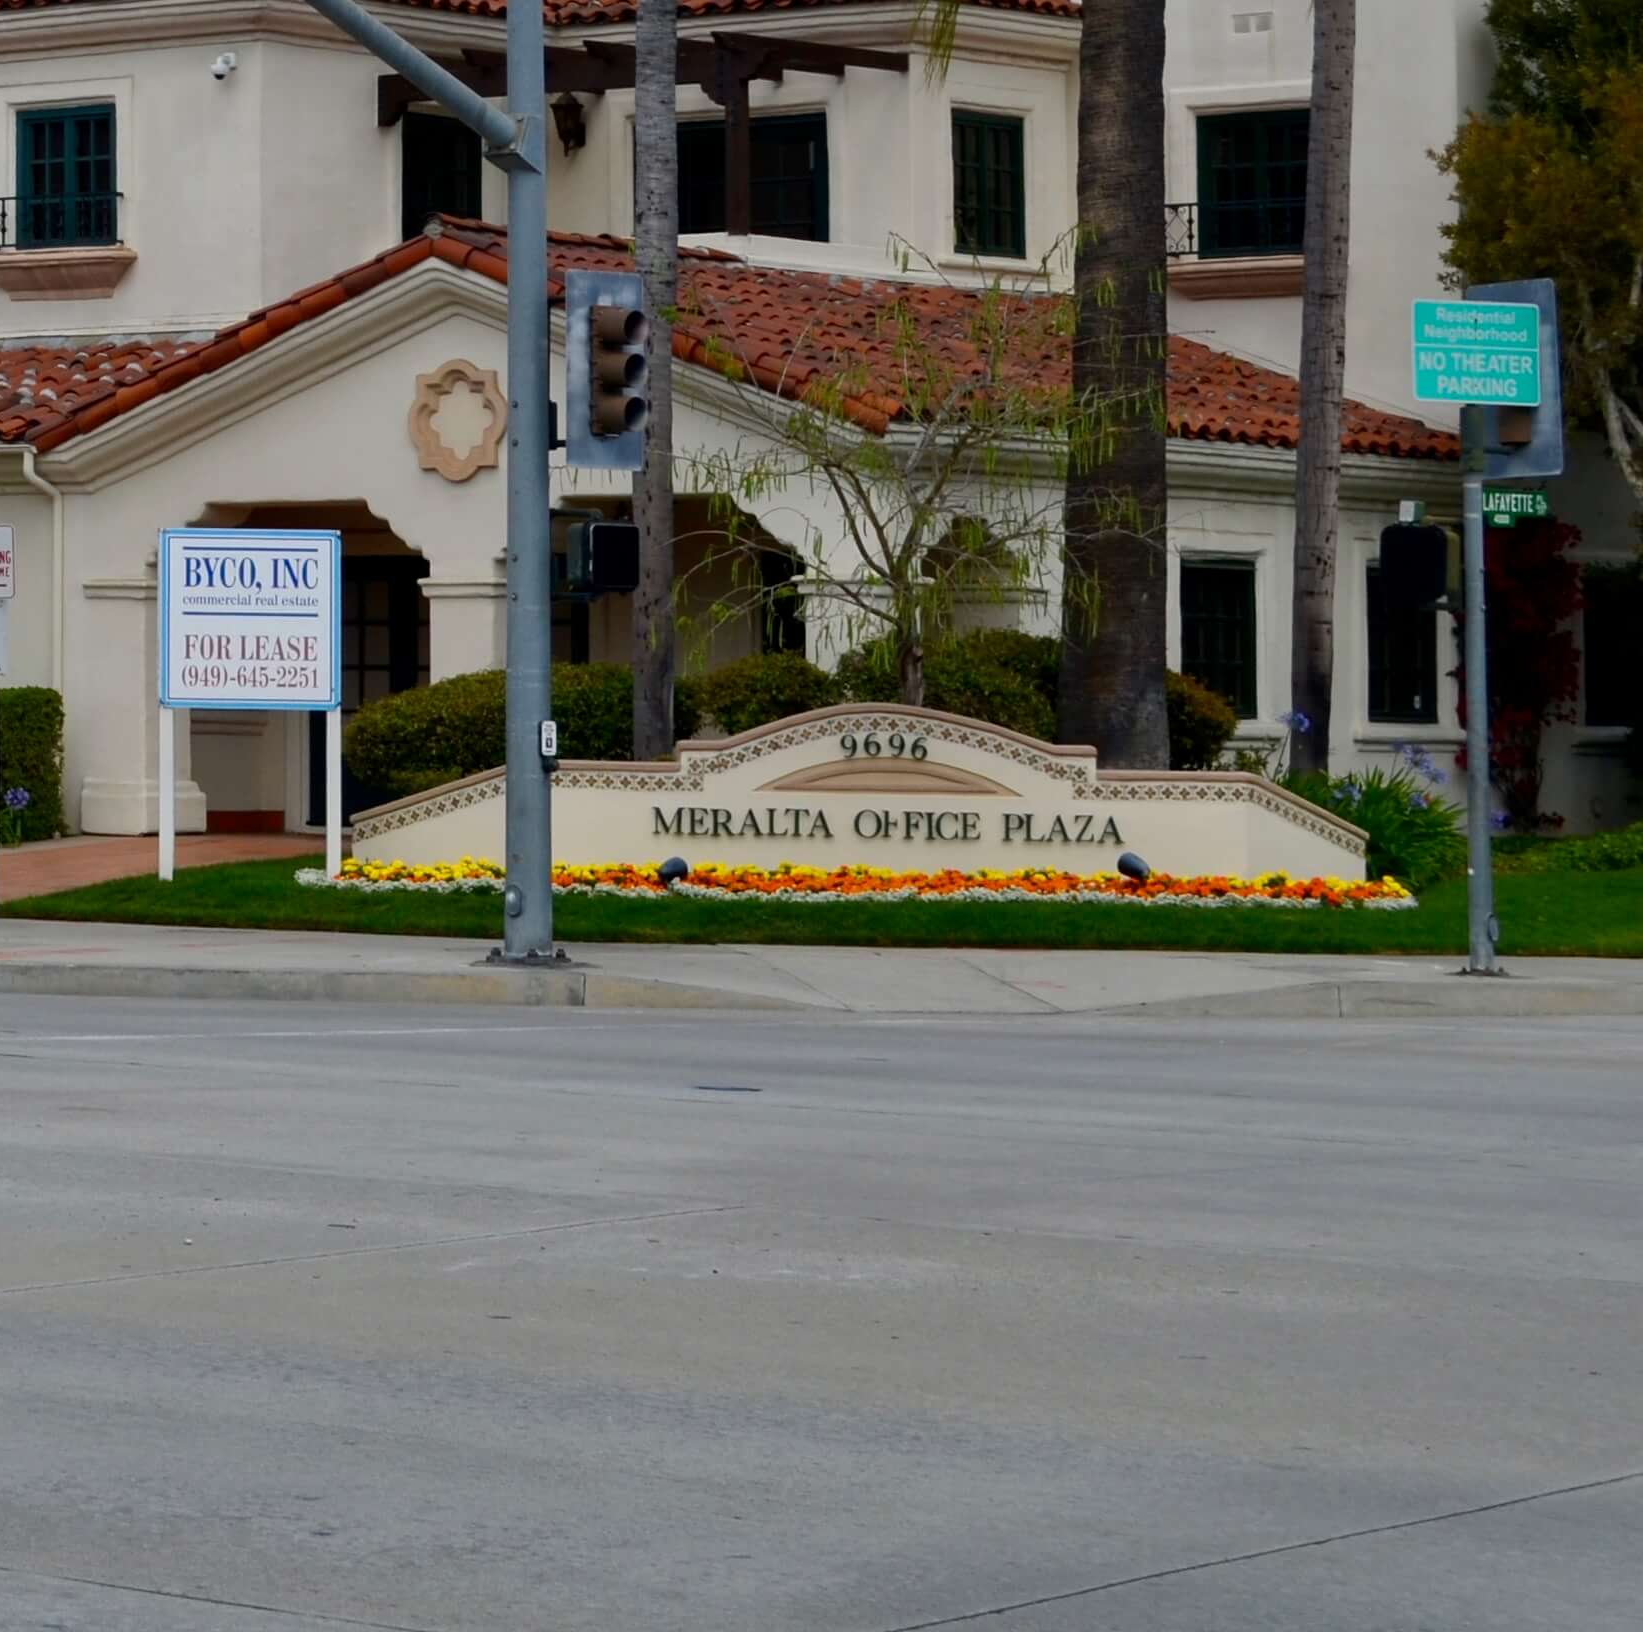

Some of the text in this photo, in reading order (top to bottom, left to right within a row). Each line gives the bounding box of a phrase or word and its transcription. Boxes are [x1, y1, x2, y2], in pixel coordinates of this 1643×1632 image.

[1435, 306, 1516, 325] Residential
[1423, 324, 1528, 343] Neighborhood
[1418, 350, 1533, 375] NO THEATER
[1436, 375, 1518, 398] PARKING
[1483, 492, 1534, 513] LAFAYETTE
[183, 556, 319, 595] BYCO, INC
[182, 594, 319, 608] commercial real estate
[184, 633, 319, 662] FOR LEASE
[181, 665, 320, 689] (949)-645-2251
[839, 732, 929, 761] 9696
[651, 805, 1125, 846] MERALTA OFFICE PLAZA
